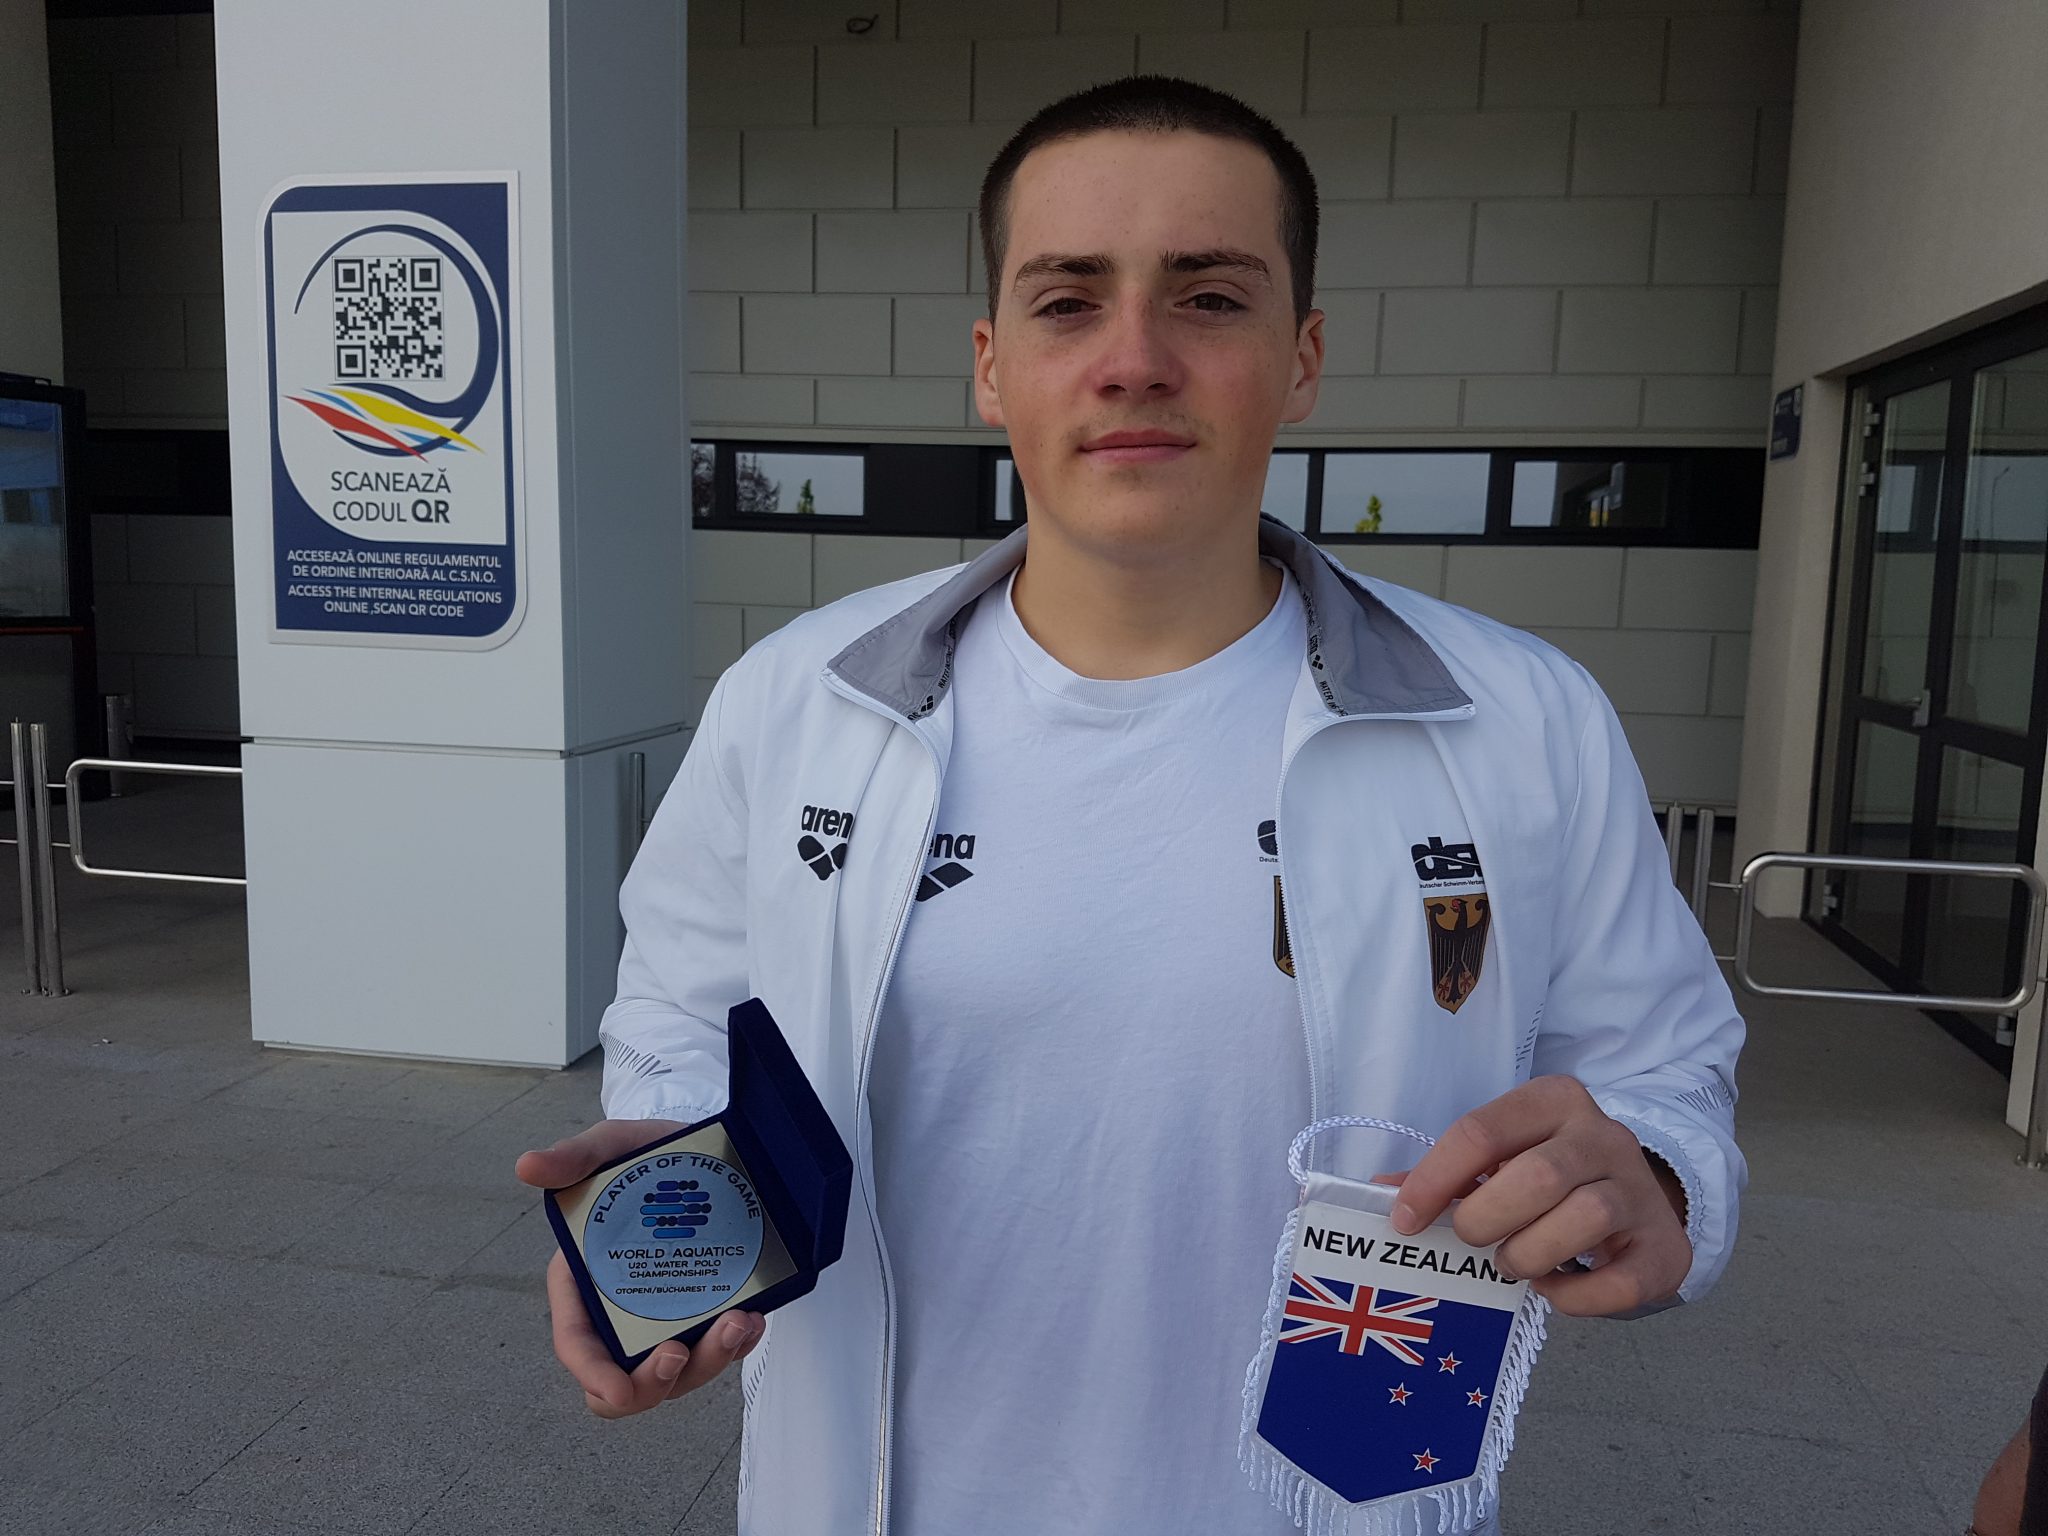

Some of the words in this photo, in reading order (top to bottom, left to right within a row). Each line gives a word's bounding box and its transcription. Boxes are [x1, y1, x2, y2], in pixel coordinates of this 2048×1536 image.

[331, 468, 451, 493] SCANEAZĂ
[333, 501, 407, 523] CODUL
[412, 499, 450, 524] QR
[287, 549, 354, 564] ACCESEAZĂ
[357, 551, 401, 565] ONLINE
[404, 553, 502, 569] REGULAMENTUL
[293, 565, 309, 577] DE
[311, 565, 356, 578] ORDINE
[359, 566, 430, 581] INTERIOARĂ
[432, 570, 447, 582] AL
[449, 570, 496, 583] C.S.N.O.
[288, 584, 332, 597] ACCESS
[333, 586, 356, 598] THE
[359, 587, 417, 600] INTERNAL
[419, 589, 502, 604] REGULATIONS
[324, 600, 368, 614] ONLINE
[408, 603, 427, 616] QR
[429, 604, 464, 617] CODE
[801, 804, 854, 839] aren
[593, 1164, 651, 1224] PLAYER
[656, 1155, 684, 1169] OF
[690, 1155, 727, 1175] THE
[727, 1174, 761, 1220] GAME
[608, 1248, 665, 1260] WORLD
[672, 1246, 745, 1259] AQUATICS
[1303, 1226, 1375, 1260] NEW
[628, 1261, 648, 1270] U20
[653, 1260, 688, 1269] WATER
[694, 1259, 721, 1268] POLO
[629, 1268, 719, 1279] CHAMPIONSHIPS
[615, 1285, 707, 1295] OTOPENI/BUCHAREST
[711, 1284, 731, 1292] 2023
